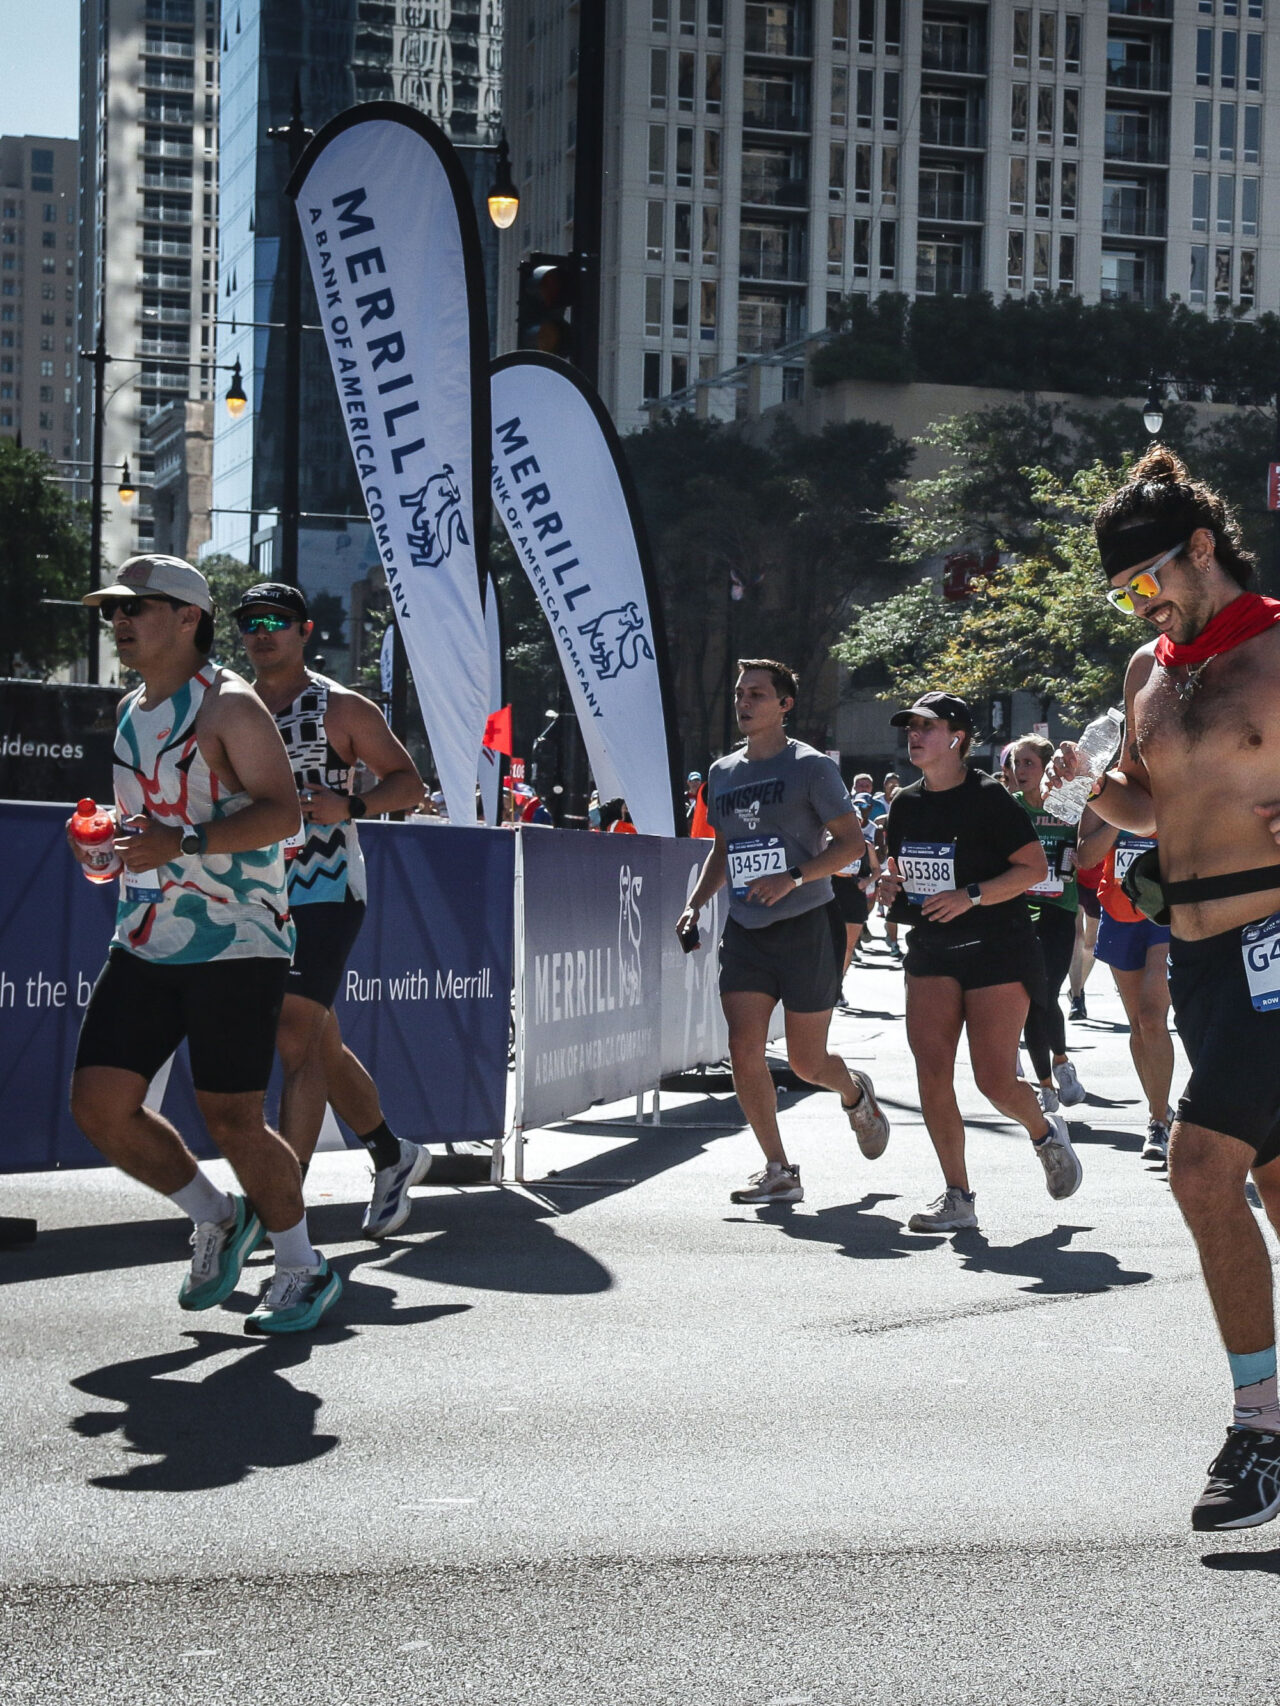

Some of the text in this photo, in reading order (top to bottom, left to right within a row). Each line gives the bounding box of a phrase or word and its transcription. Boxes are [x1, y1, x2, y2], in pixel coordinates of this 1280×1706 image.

[331, 187, 426, 475] MERRILL
[309, 207, 411, 618] A BANK OF AMERICA COMPANY
[495, 416, 591, 612] MERRILL
[491, 452, 604, 718] ANK OF AMERICA COMPANY
[0, 733, 84, 759] idences
[715, 780, 786, 817] FINISHER
[732, 852, 781, 878] J34572
[902, 860, 950, 882] J35388
[26, 971, 67, 1008] the
[346, 967, 494, 1002] Run with Merrill.
[535, 947, 615, 1026] MERRILL
[1262, 997, 1279, 1006] ROW
